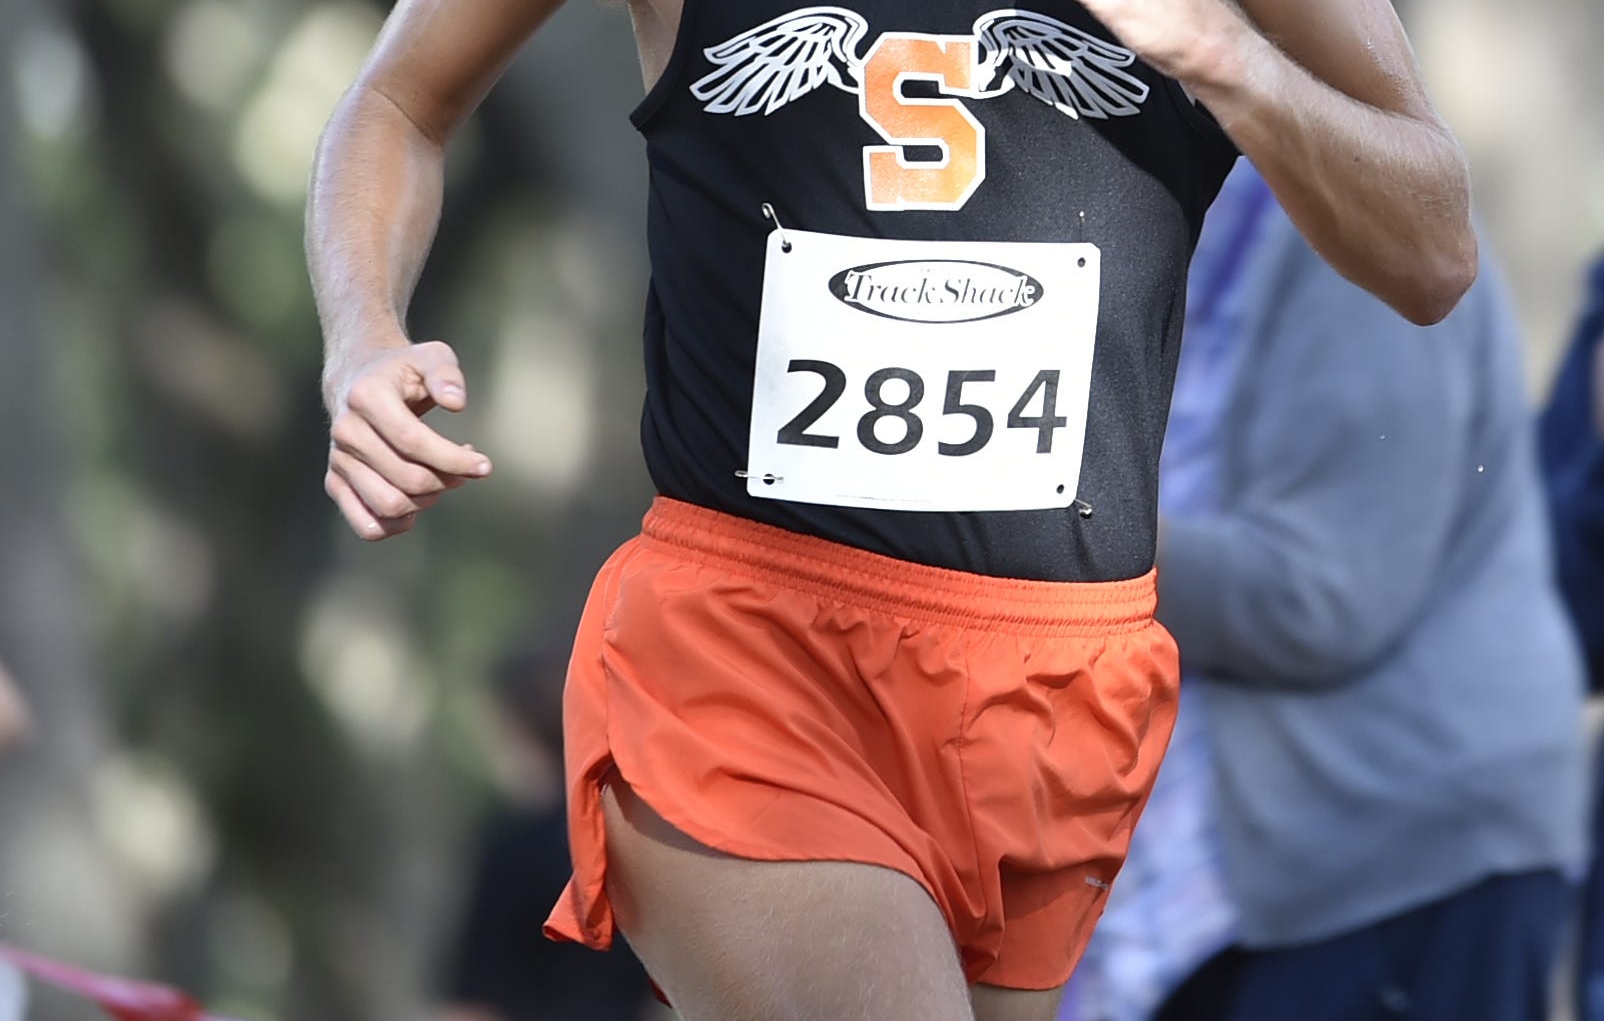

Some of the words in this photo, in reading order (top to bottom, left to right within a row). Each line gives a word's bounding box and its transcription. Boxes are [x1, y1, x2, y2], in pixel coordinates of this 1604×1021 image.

[859, 31, 986, 211] S
[845, 271, 936, 304] Track
[939, 276, 1035, 307] Shack
[775, 358, 1068, 457] 2854
